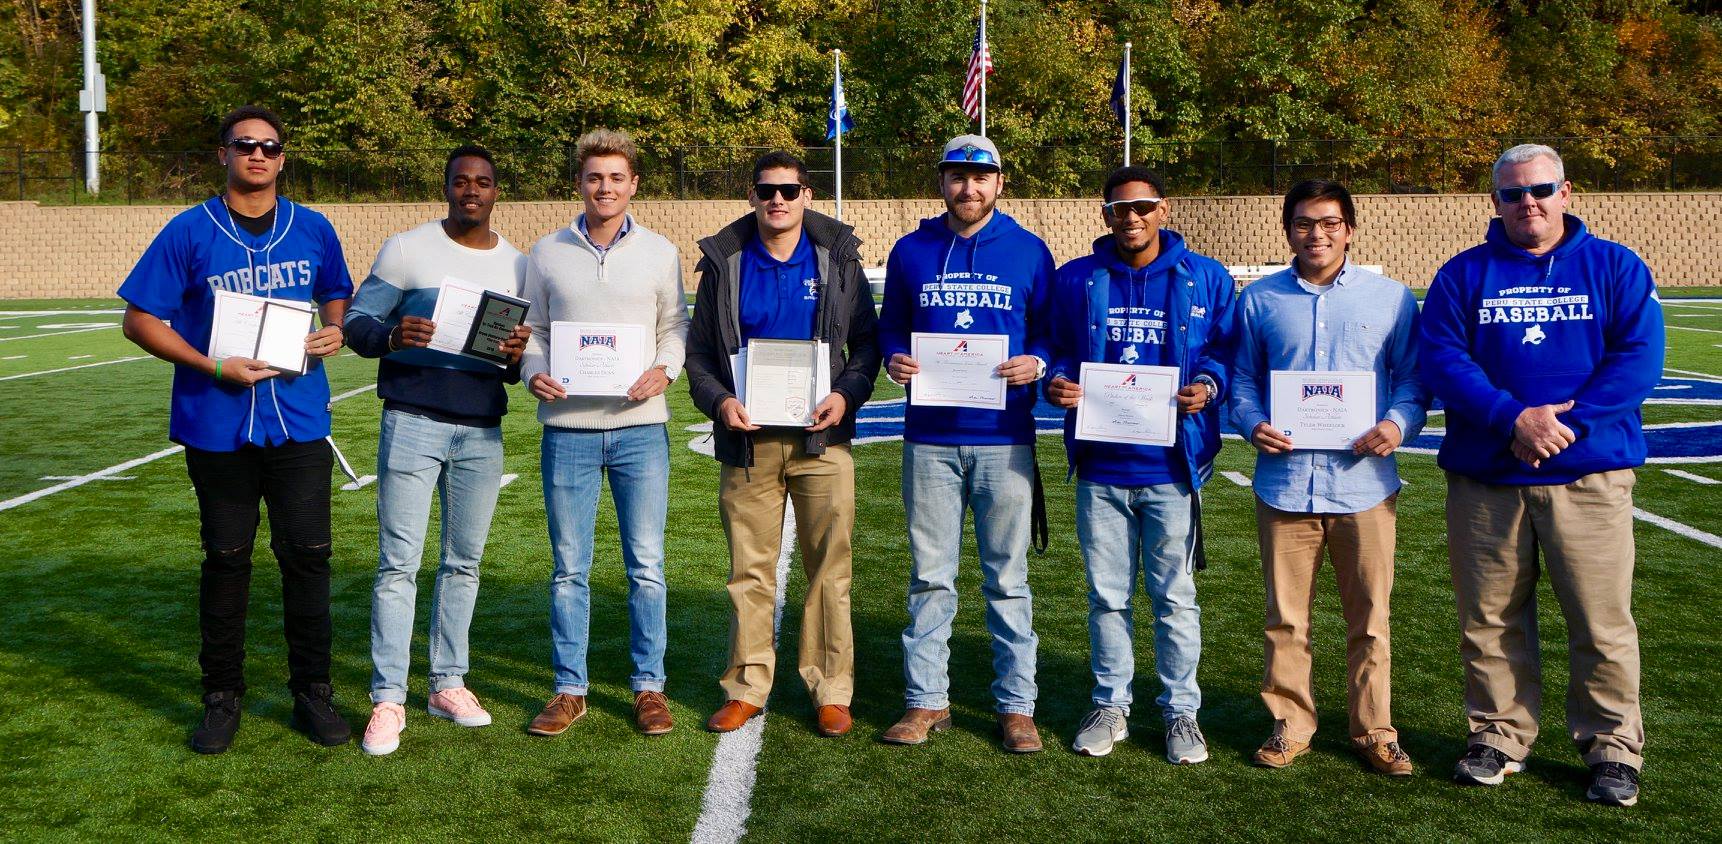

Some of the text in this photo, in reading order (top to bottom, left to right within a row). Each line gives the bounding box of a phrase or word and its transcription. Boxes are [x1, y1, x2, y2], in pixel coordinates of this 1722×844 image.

[207, 260, 312, 297] BOBCATS
[935, 272, 999, 282] PROPERTY OF
[976, 284, 1009, 293] COLLEGE
[1498, 286, 1554, 297] PROPERTY
[919, 291, 1013, 311] BASEBALL
[1546, 296, 1586, 305] COLLEGE
[1107, 307, 1152, 315] ROPERTY
[1478, 304, 1594, 325] BASEBALL
[581, 335, 615, 348] NAIA
[1303, 385, 1342, 399] NAIA
